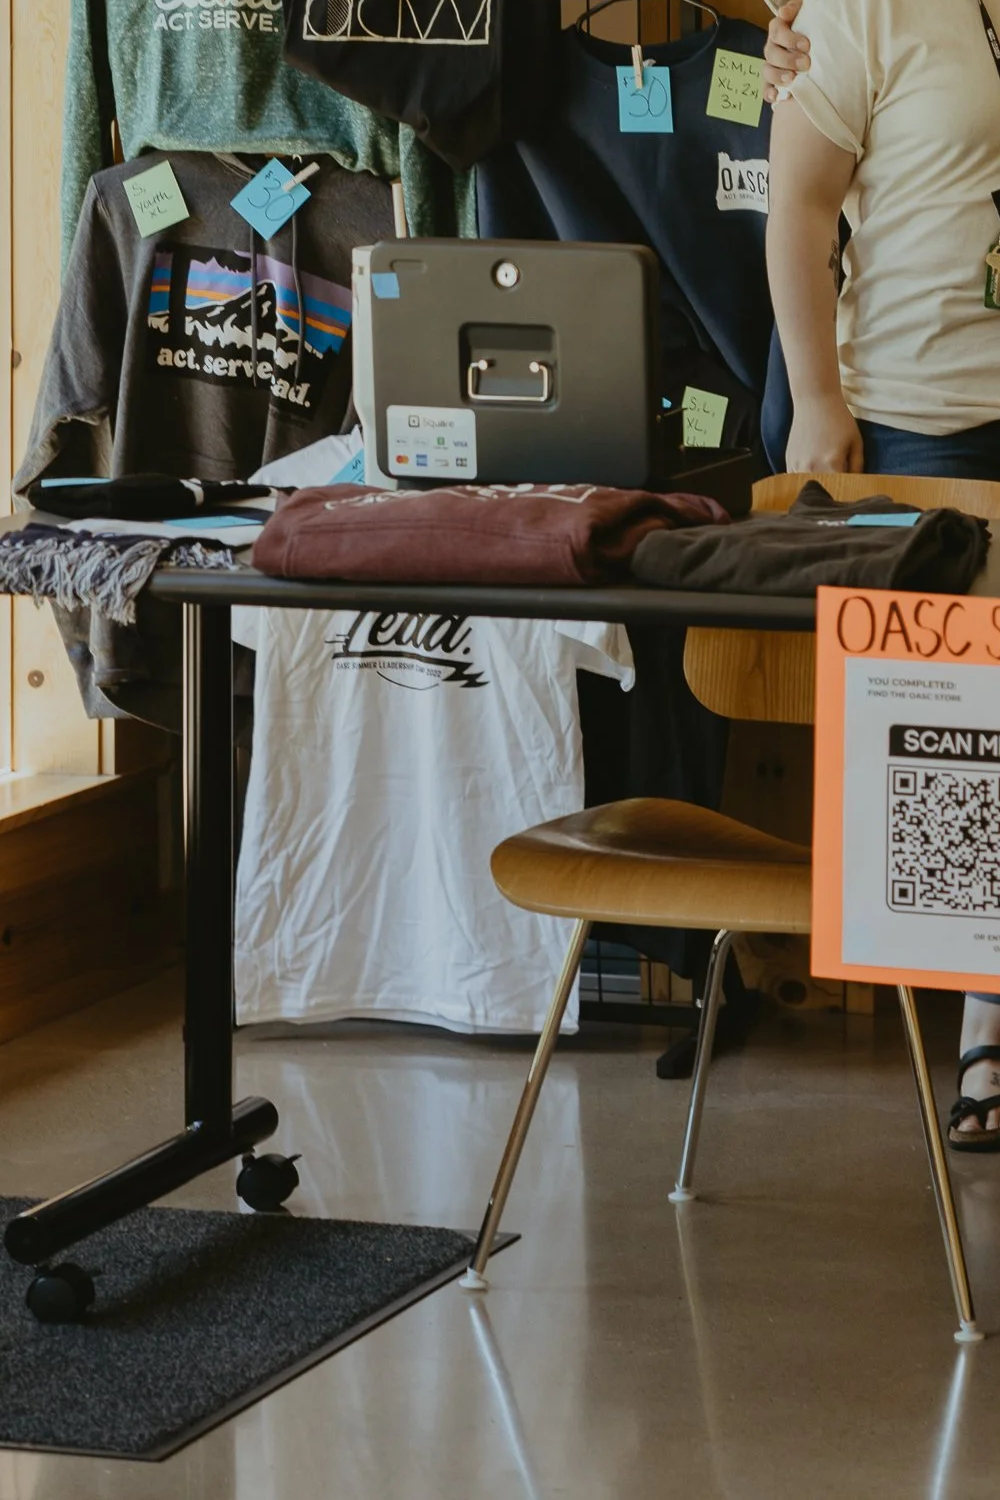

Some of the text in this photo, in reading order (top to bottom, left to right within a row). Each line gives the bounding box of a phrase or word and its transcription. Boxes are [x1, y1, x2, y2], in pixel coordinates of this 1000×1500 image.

[198, 9, 279, 33] SERVE.
[422, 417, 455, 429] Square
[836, 595, 972, 658] OASC
[378, 661, 415, 670] LEADERSHIP
[868, 677, 889, 686] YOU
[867, 689, 962, 703] FIND THE OASC STORE
[903, 728, 972, 755] SCAN
[973, 933, 986, 941] OR
